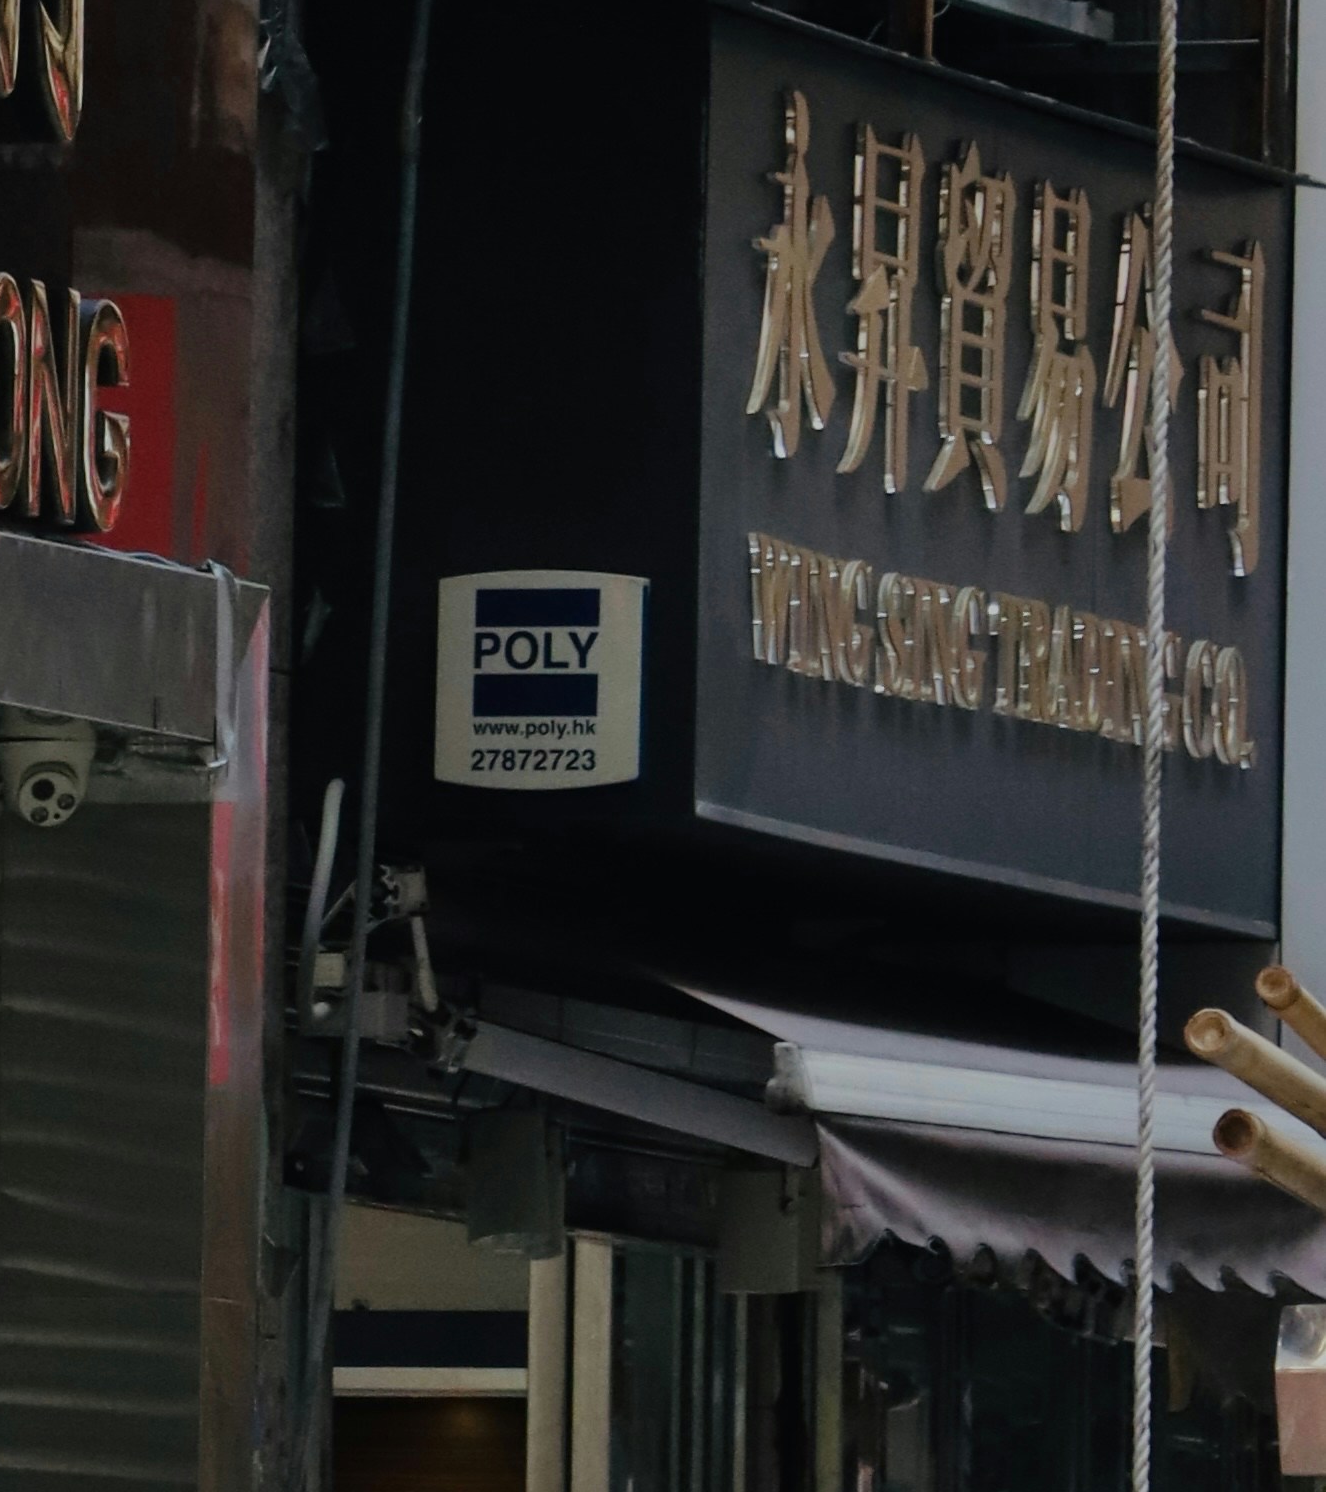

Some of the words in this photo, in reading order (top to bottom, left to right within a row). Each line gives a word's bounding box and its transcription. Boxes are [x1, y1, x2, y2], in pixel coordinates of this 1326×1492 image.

[748, 531, 873, 687] WING
[875, 572, 986, 710] SING
[472, 630, 599, 670] POLY
[472, 718, 597, 740] www.poly.hk
[471, 747, 597, 772] 27872723
